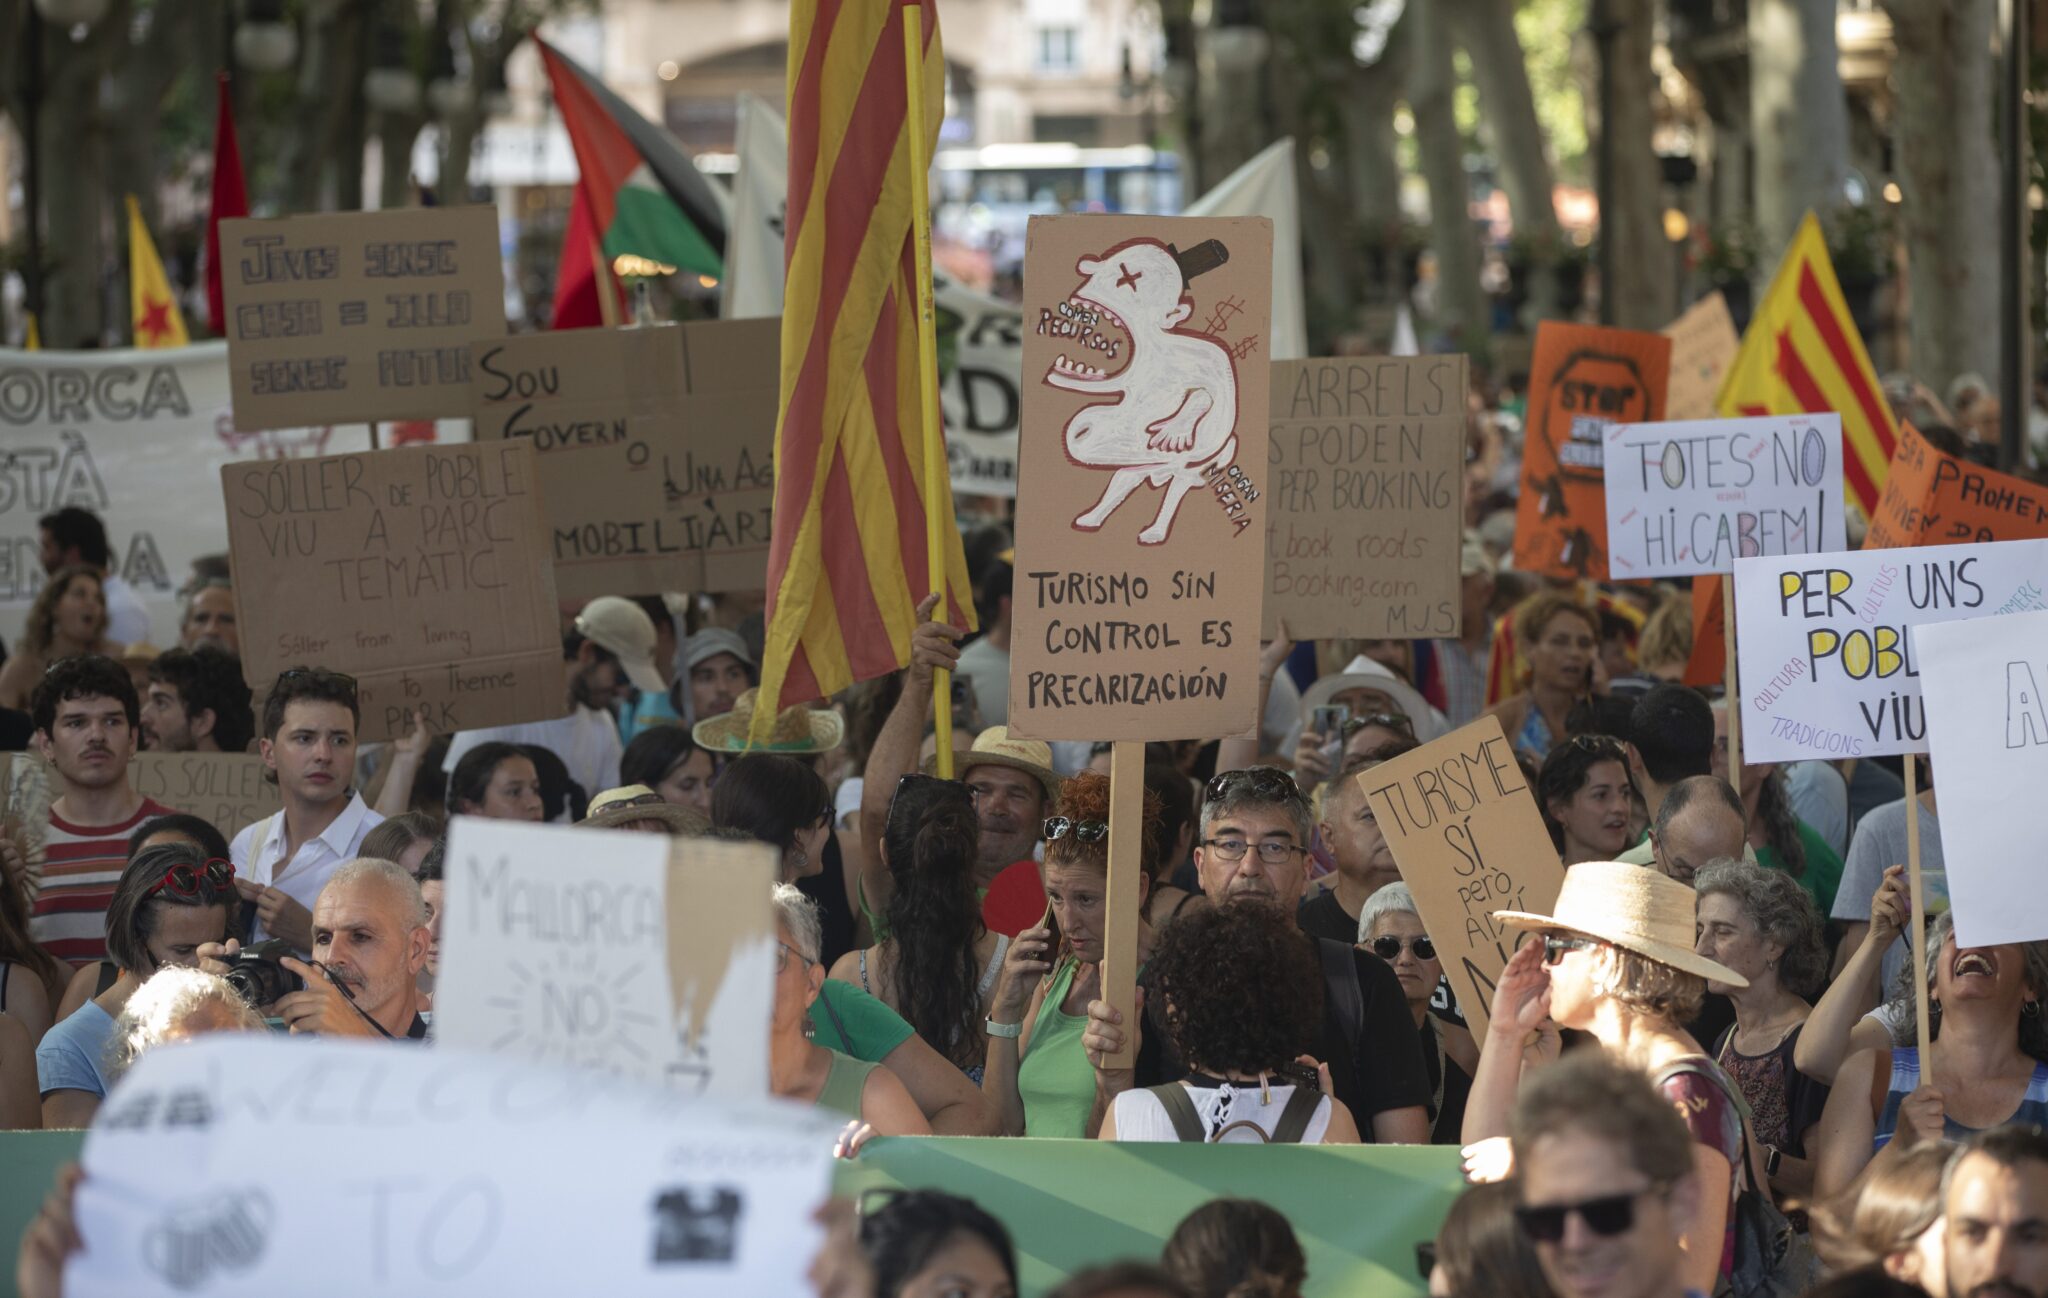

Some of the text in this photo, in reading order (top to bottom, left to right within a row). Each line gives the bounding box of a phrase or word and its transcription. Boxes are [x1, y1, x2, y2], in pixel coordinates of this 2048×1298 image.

[1036, 307, 1122, 359] RECURSOS
[1058, 302, 1100, 326] COMEN
[1289, 362, 1453, 419] ARRELS
[1561, 380, 1636, 415] STOP
[1299, 422, 1424, 466] PODEN
[1624, 431, 1755, 493] TOTES
[1773, 427, 1827, 487] NO
[389, 483, 413, 507] DE
[426, 446, 527, 500] POBLE
[1201, 461, 1252, 539] MISERIA
[1227, 464, 1261, 504] CAGAN
[1278, 468, 1452, 513] PER BOOKING
[257, 499, 514, 558] VIU A PARC
[1286, 527, 1333, 559] book
[323, 546, 508, 602] TEMÀTIC
[1272, 561, 1419, 608] Booking.com
[1779, 557, 1985, 619] PER UNS
[1858, 563, 1899, 625] CULTIUS
[1045, 619, 1232, 655] CONTROL ES
[1753, 656, 1809, 713] CULTURA
[1369, 736, 1528, 838] TURISME
[1443, 814, 1486, 878] SÍ
[1456, 866, 1513, 916] però
